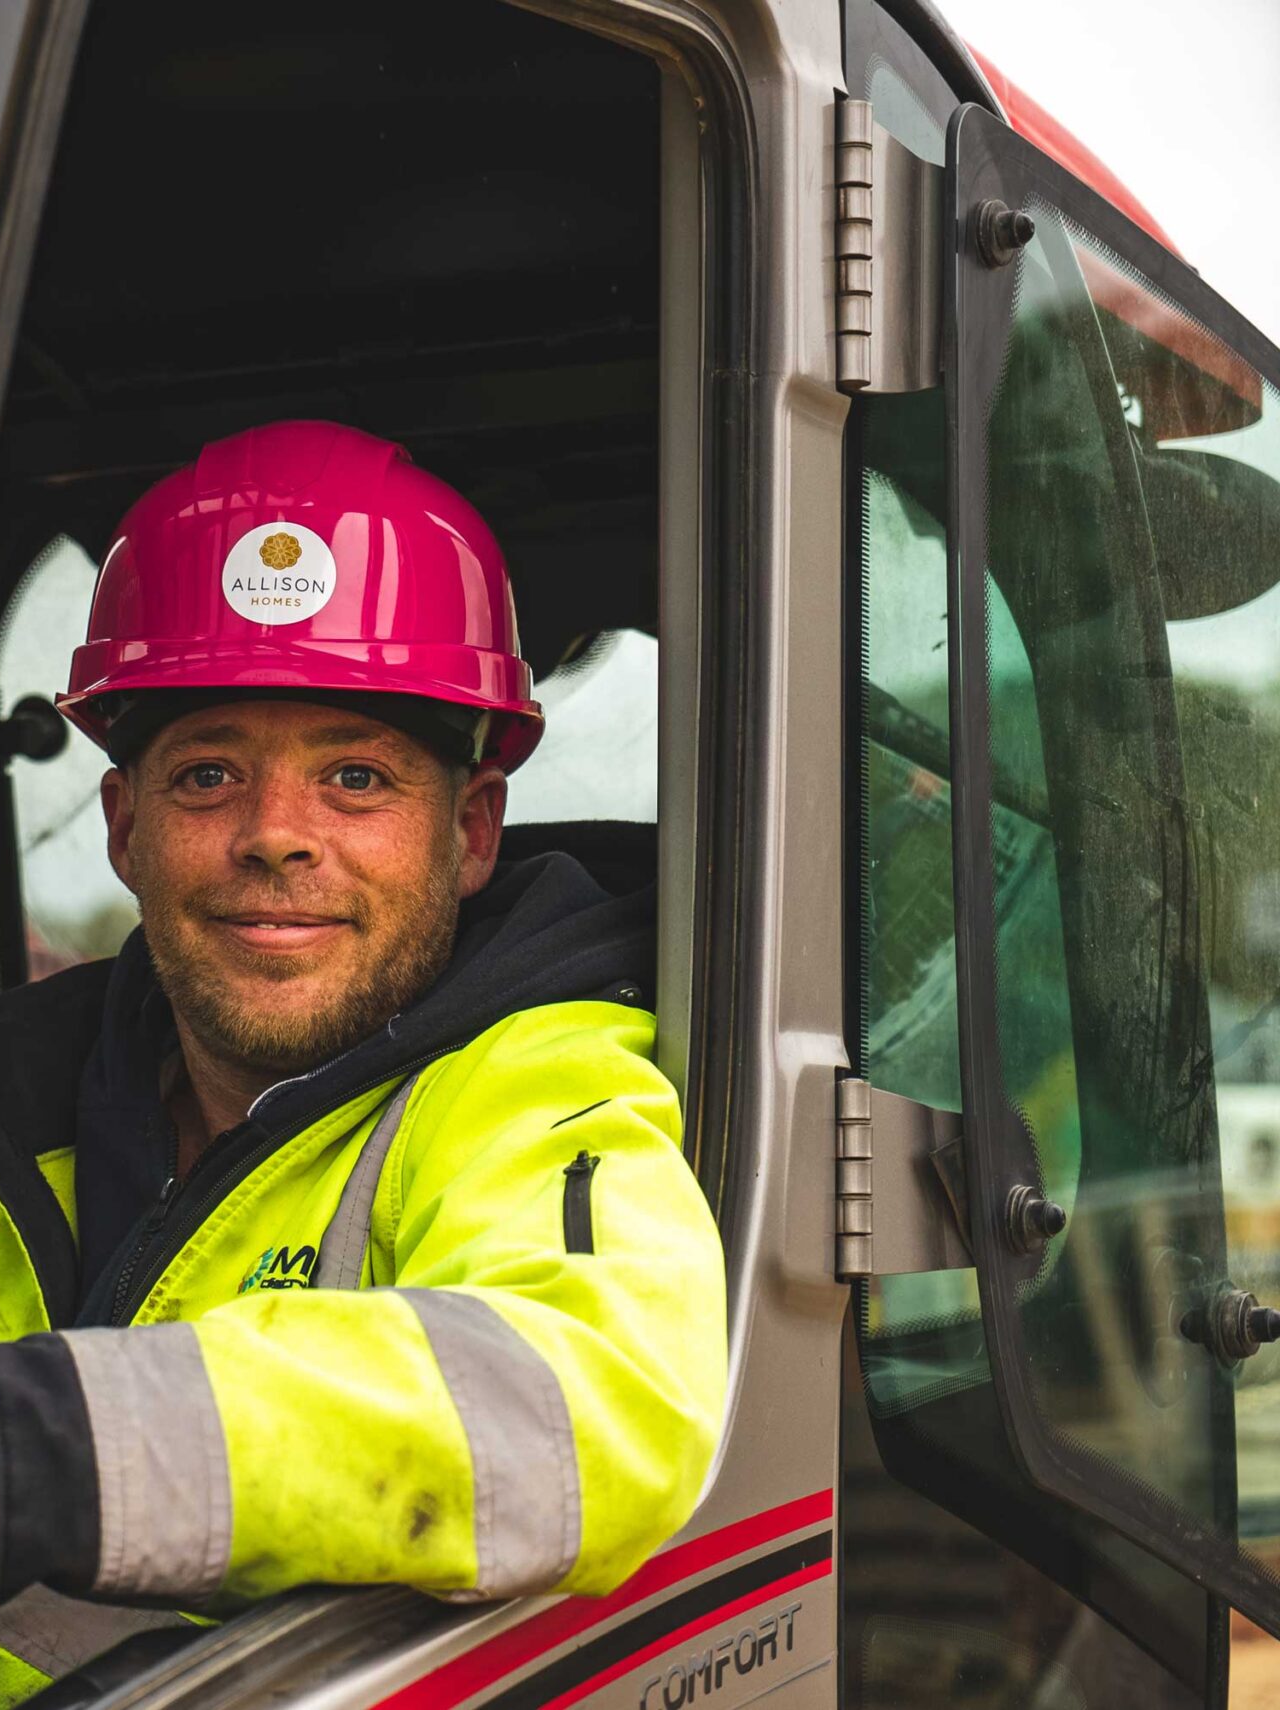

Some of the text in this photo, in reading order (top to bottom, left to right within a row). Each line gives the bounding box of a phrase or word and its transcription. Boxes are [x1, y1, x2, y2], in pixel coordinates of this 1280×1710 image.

[231, 577, 325, 594] ALLISON
[251, 597, 301, 607] HOMES
[641, 1600, 802, 1710] COMFORT
